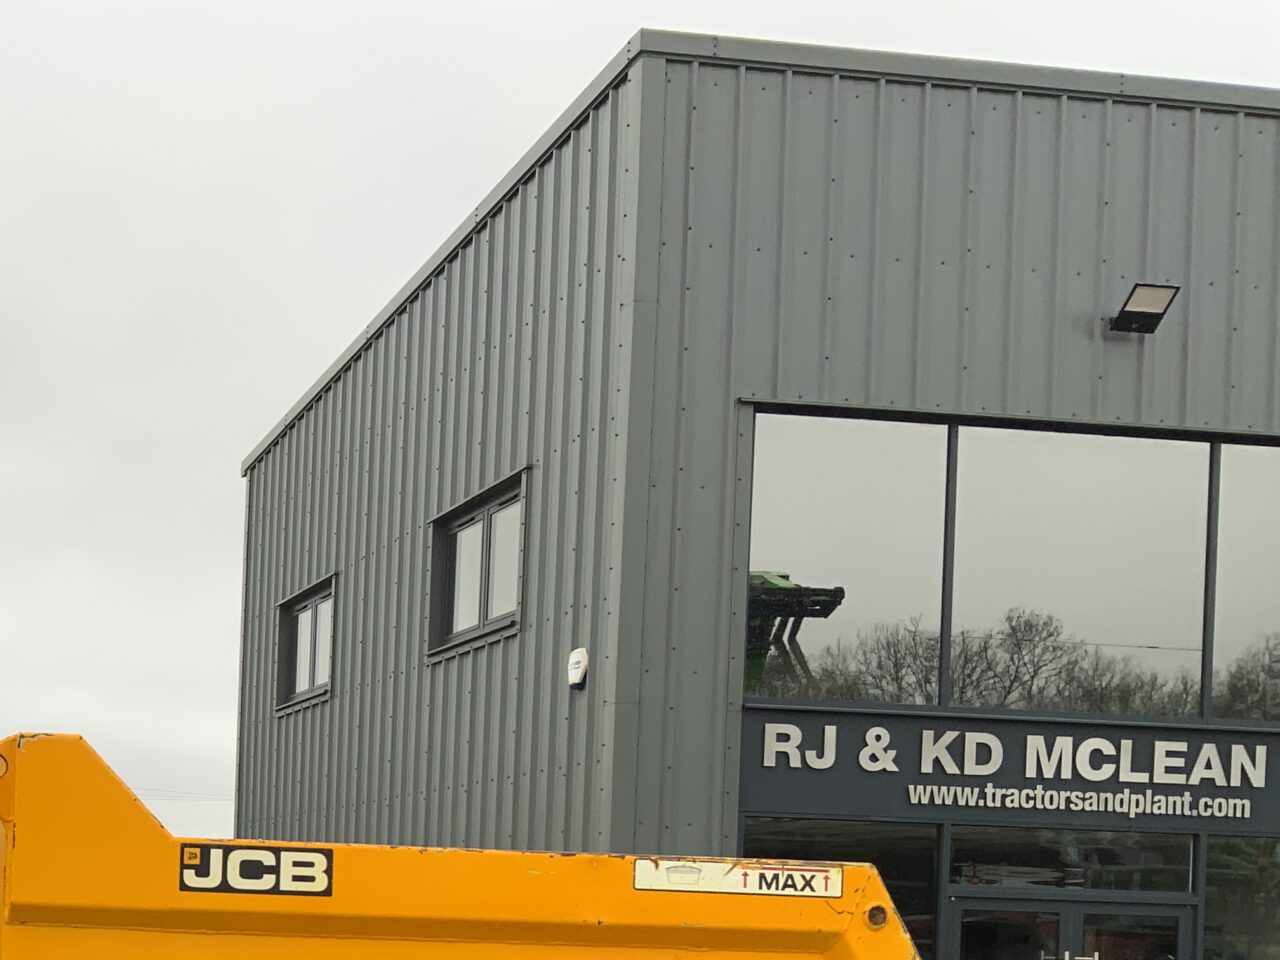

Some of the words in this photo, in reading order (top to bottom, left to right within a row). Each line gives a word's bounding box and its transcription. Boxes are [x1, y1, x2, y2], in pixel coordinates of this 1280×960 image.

[763, 723, 837, 770] RJ
[858, 727, 900, 773] &
[920, 730, 1004, 777] KD
[1024, 735, 1268, 788] MCLEAN
[907, 783, 1252, 819] www.tractorsandplant.com
[183, 848, 329, 892] JCB
[758, 872, 817, 893] MAX
